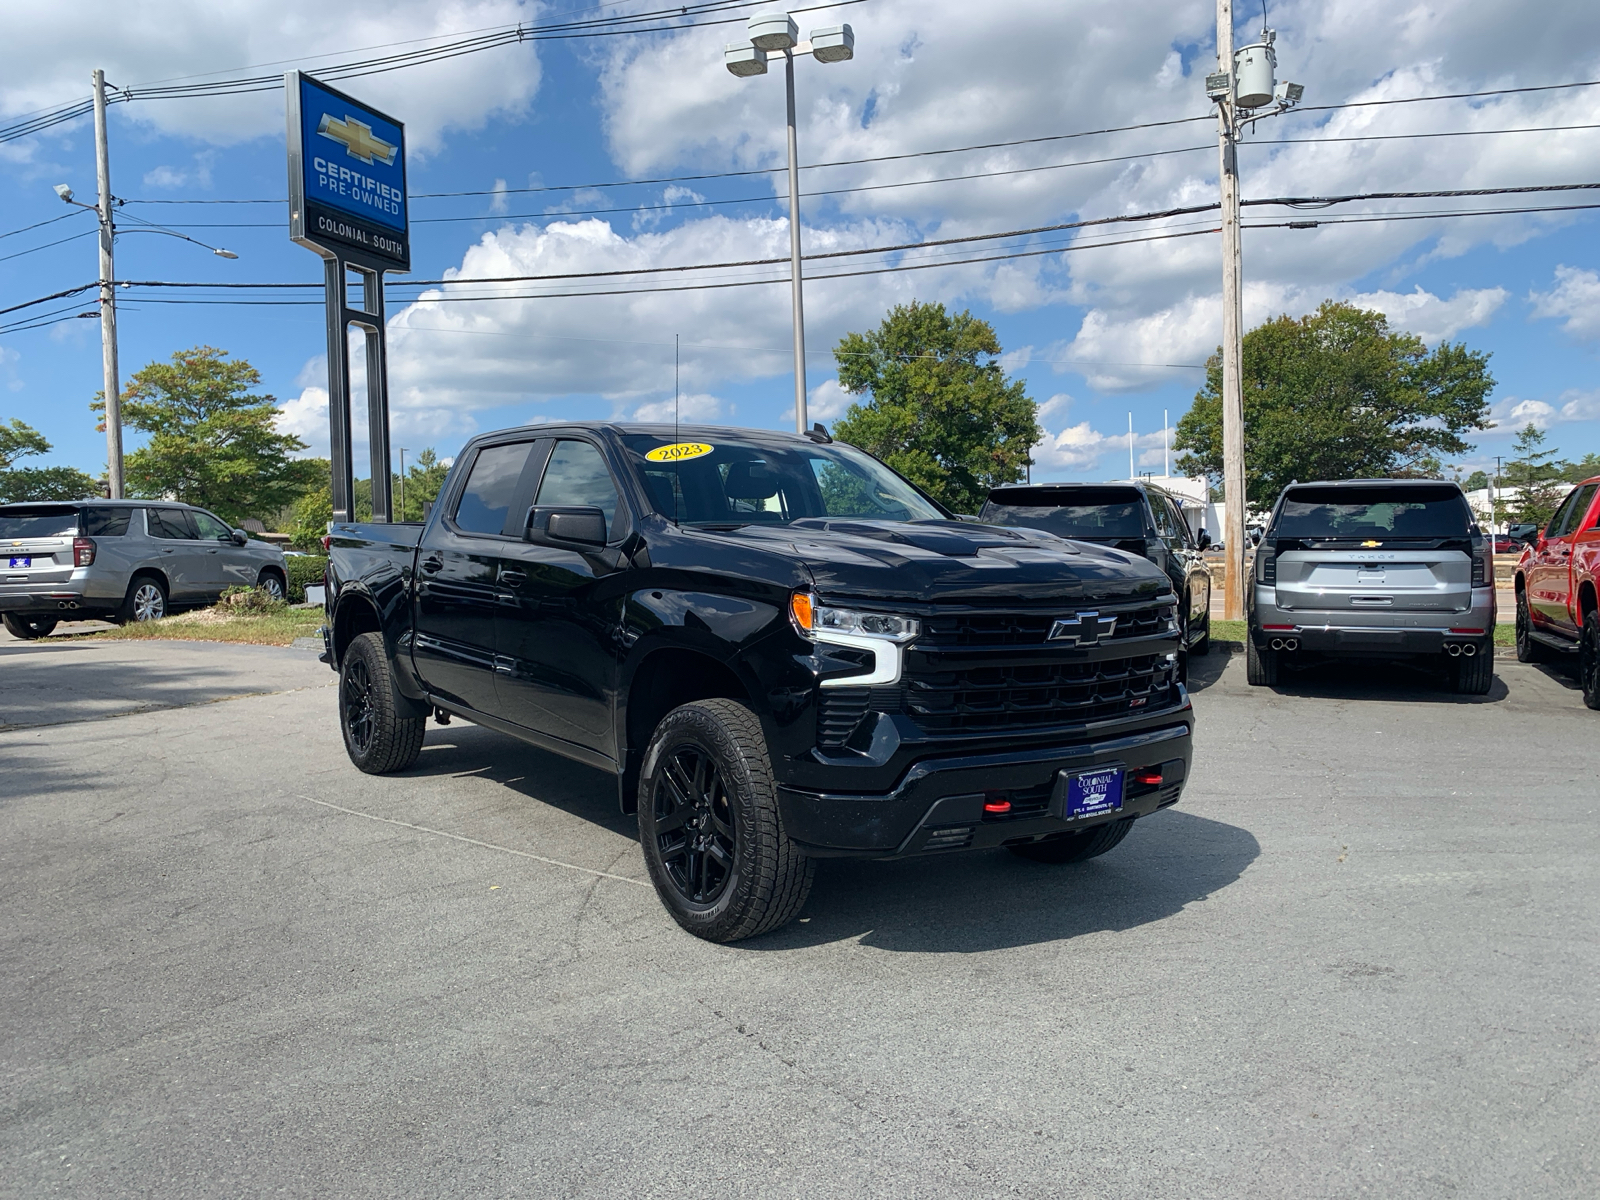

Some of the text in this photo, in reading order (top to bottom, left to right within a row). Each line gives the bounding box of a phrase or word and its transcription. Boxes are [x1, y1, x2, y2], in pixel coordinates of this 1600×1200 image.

[313, 157, 402, 203] CERTIFIED
[319, 174, 399, 215] PRE-OWNED
[318, 216, 403, 255] COLONIAL SOUTH
[659, 444, 702, 460] 2023
[1078, 775, 1113, 788] COLONIAL
[1082, 784, 1107, 795] SOUTH
